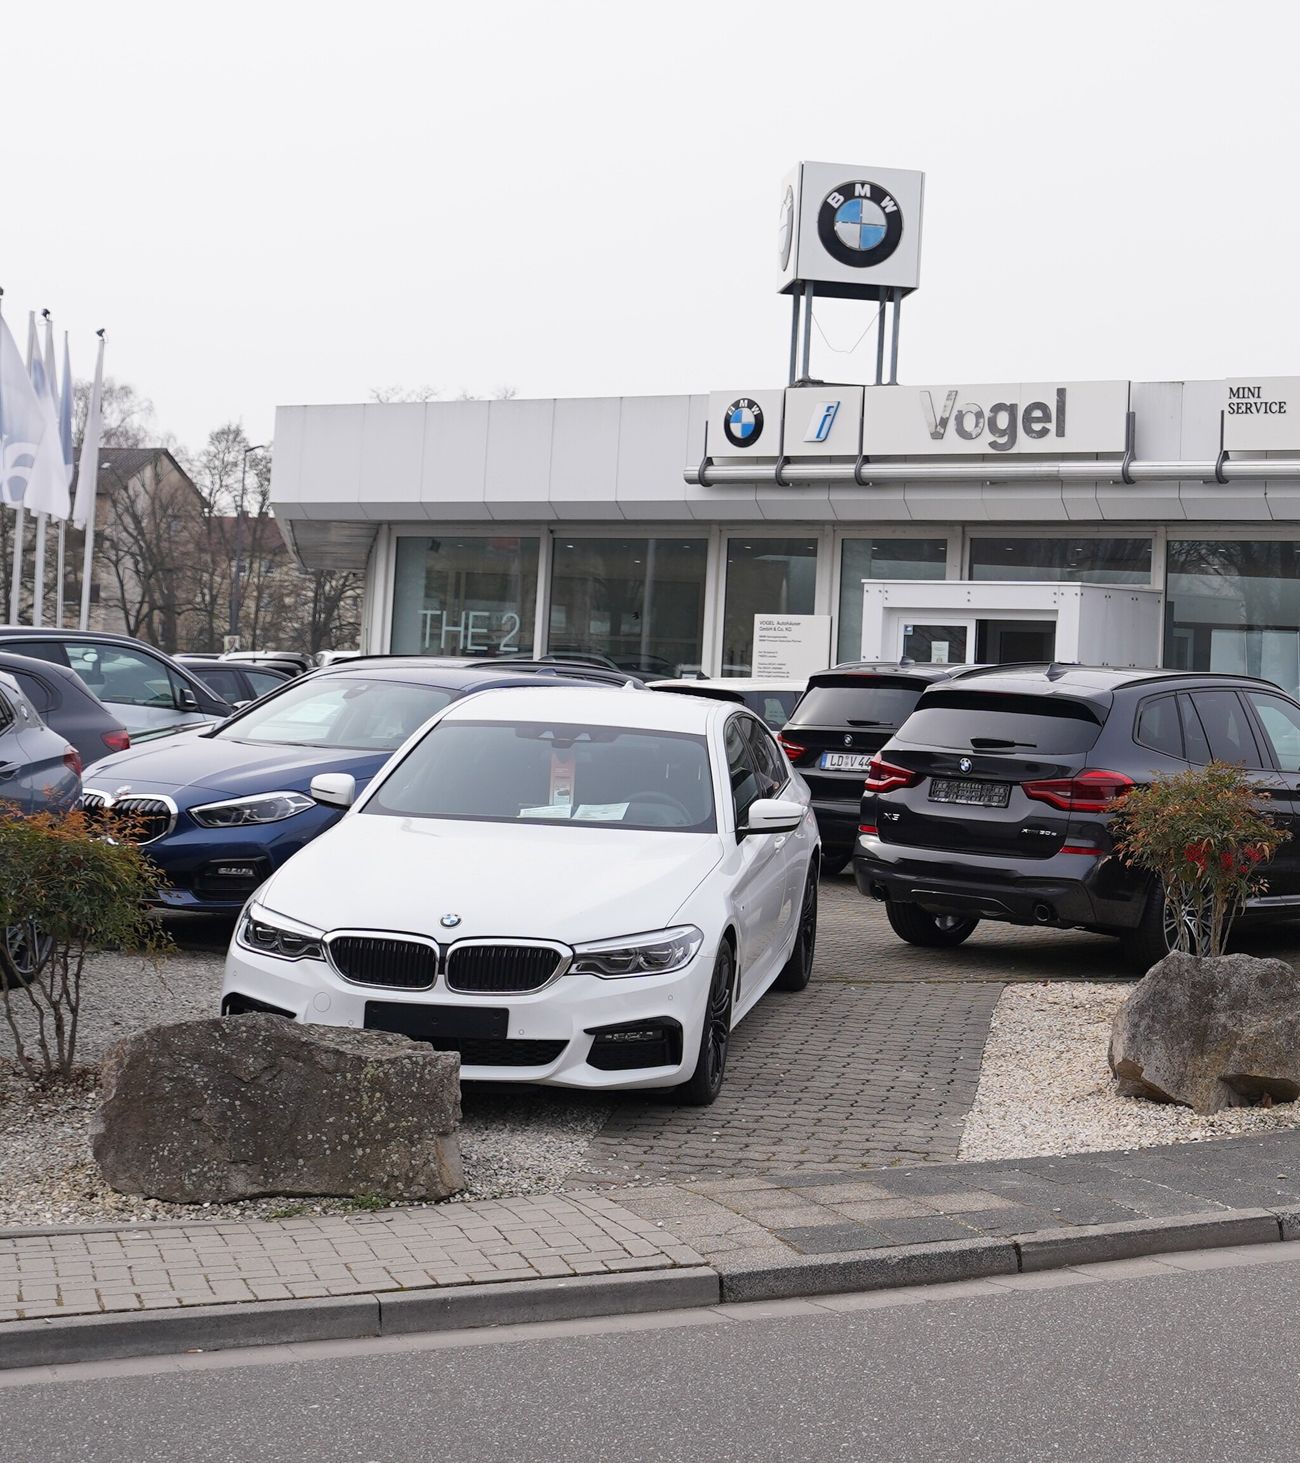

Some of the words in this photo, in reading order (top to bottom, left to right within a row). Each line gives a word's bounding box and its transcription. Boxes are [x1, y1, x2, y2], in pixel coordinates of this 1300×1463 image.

[826, 183, 898, 213] BMW
[1228, 386, 1261, 399] MINI
[727, 399, 760, 415] BMW
[1228, 401, 1286, 414] SERVICE
[920, 387, 1066, 451] Vogel
[418, 610, 490, 650] THE
[500, 612, 520, 651] 2
[830, 755, 844, 767] LD
[850, 757, 857, 767] V
